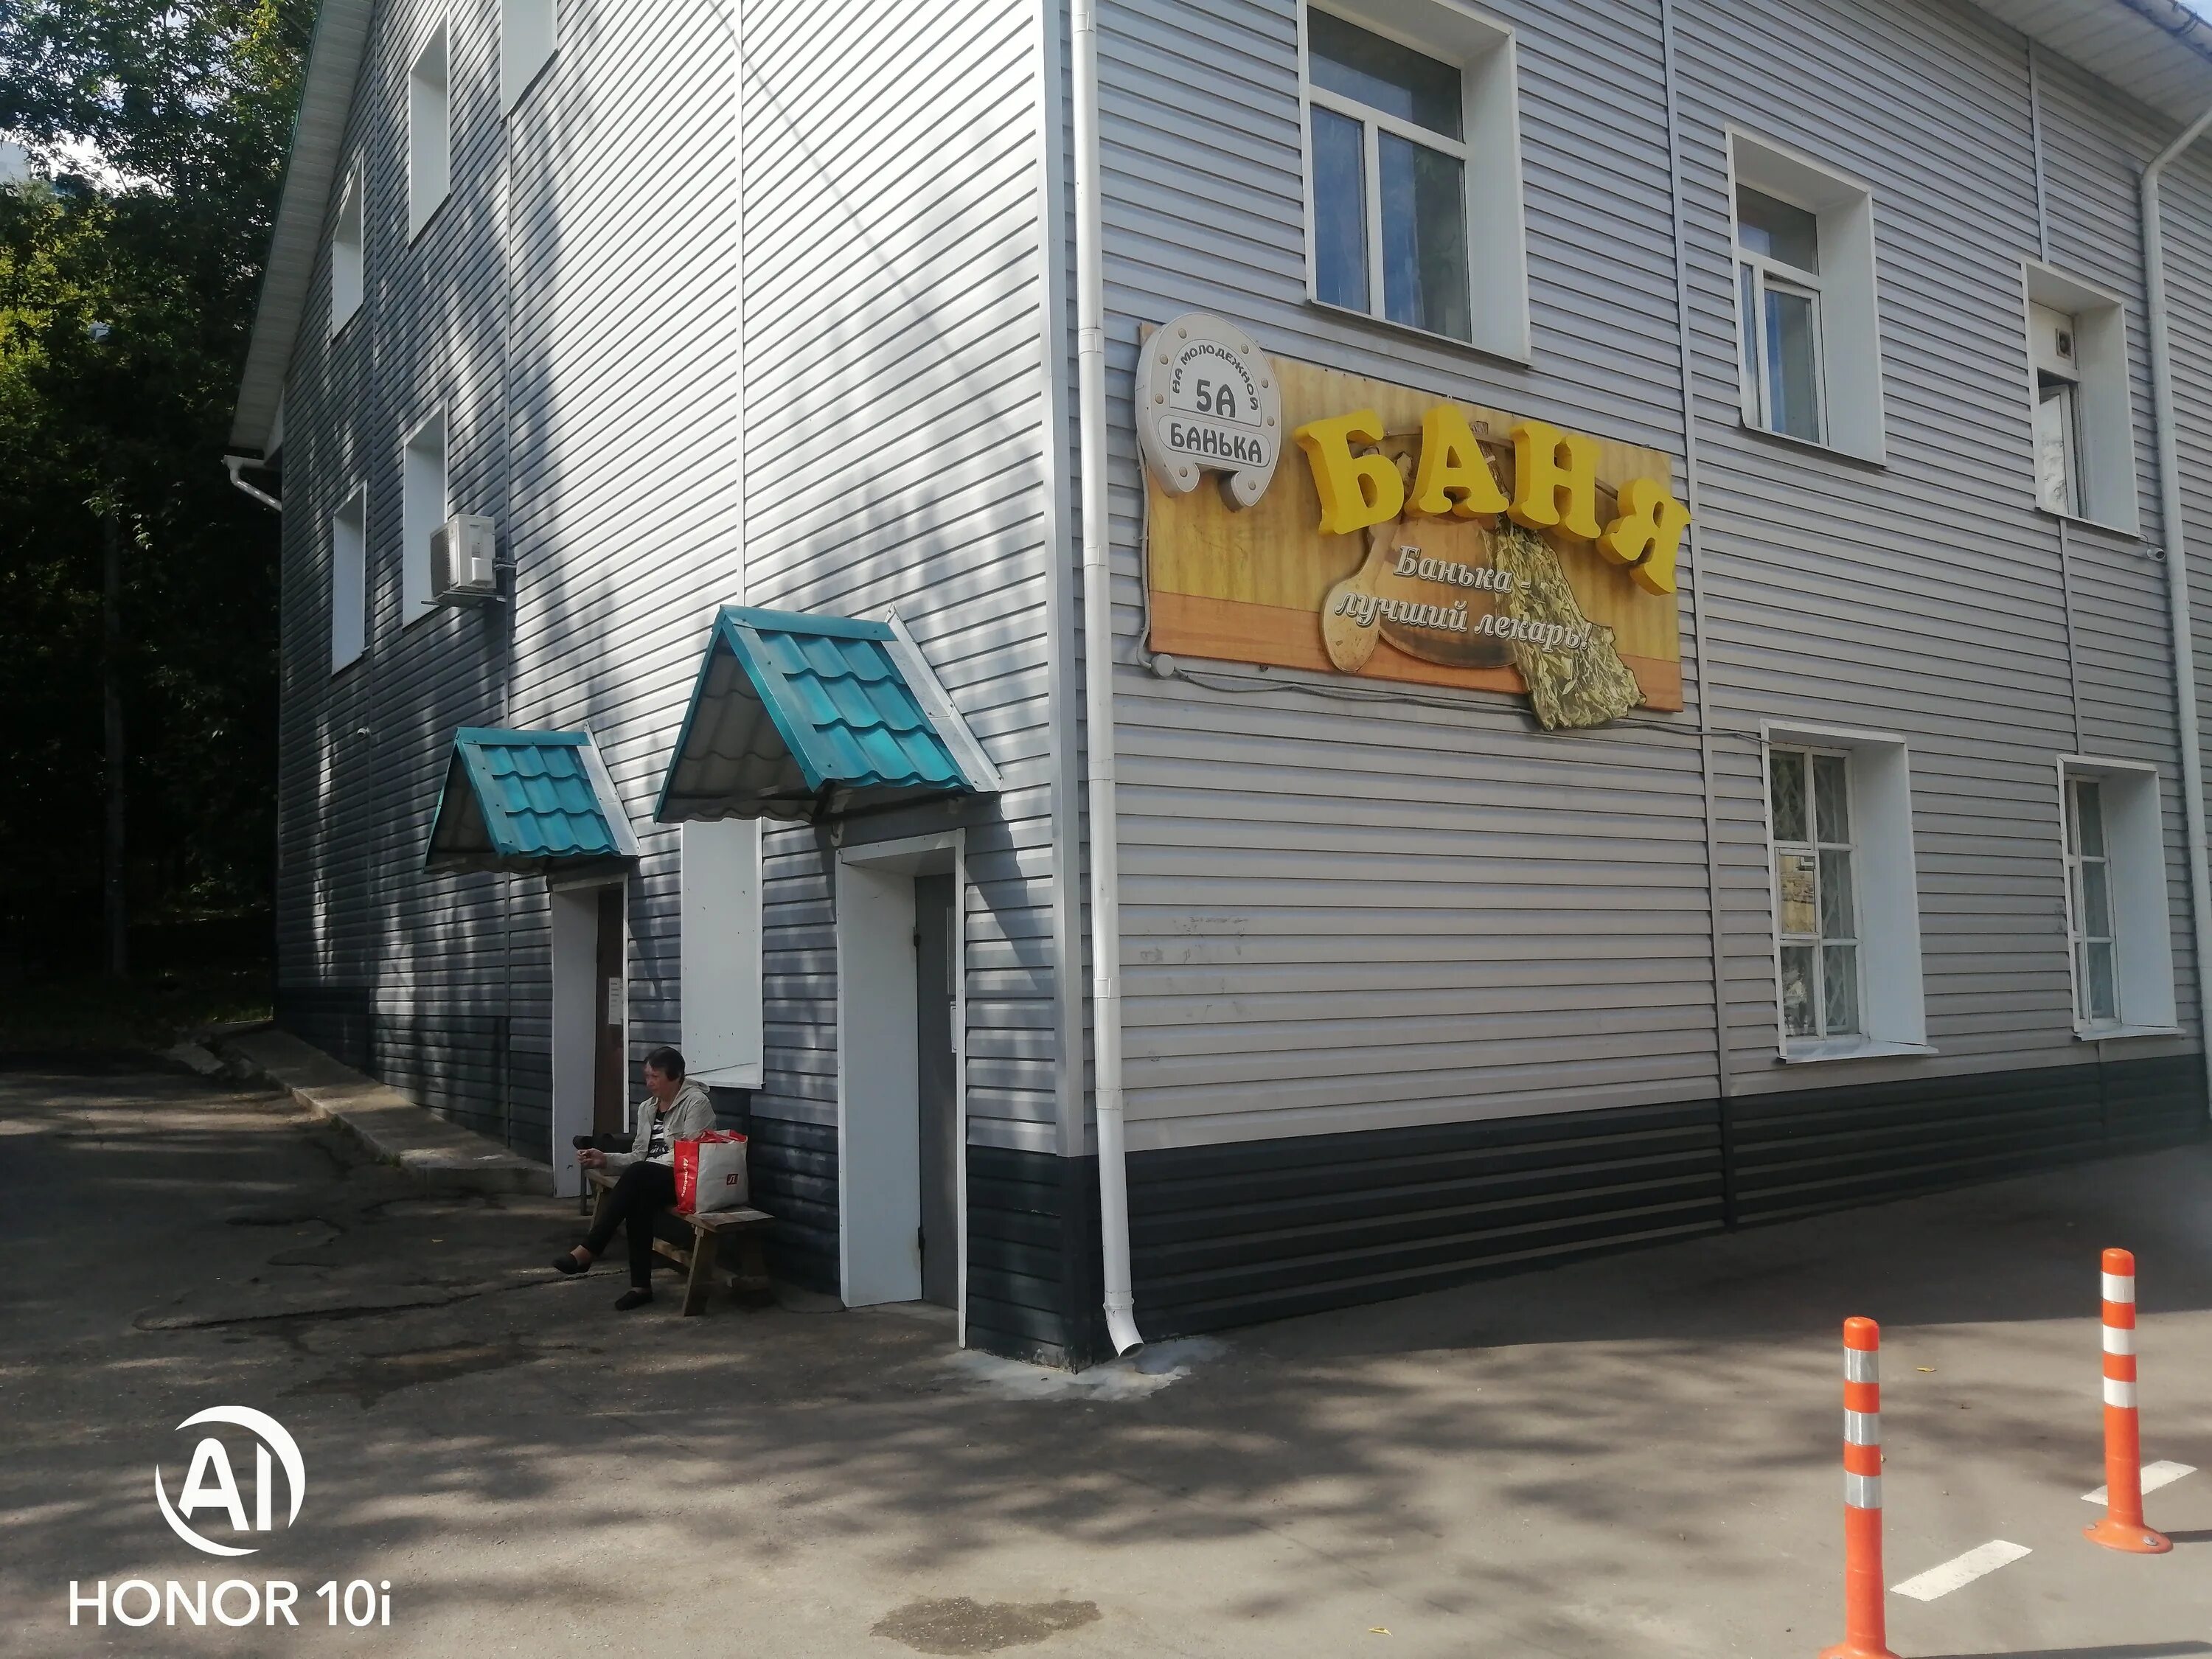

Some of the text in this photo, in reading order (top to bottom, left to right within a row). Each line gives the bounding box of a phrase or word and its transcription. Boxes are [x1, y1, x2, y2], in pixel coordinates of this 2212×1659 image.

[1172, 344, 1259, 411] НА МОЛОДЕЖНОЙ
[1196, 378, 1236, 418] 5А
[1170, 422, 1262, 464] БАНЬКА
[1294, 404, 1691, 596] БАНЯ
[1392, 545, 1513, 594] Банька
[1333, 591, 1593, 653] лучший лекарь!
